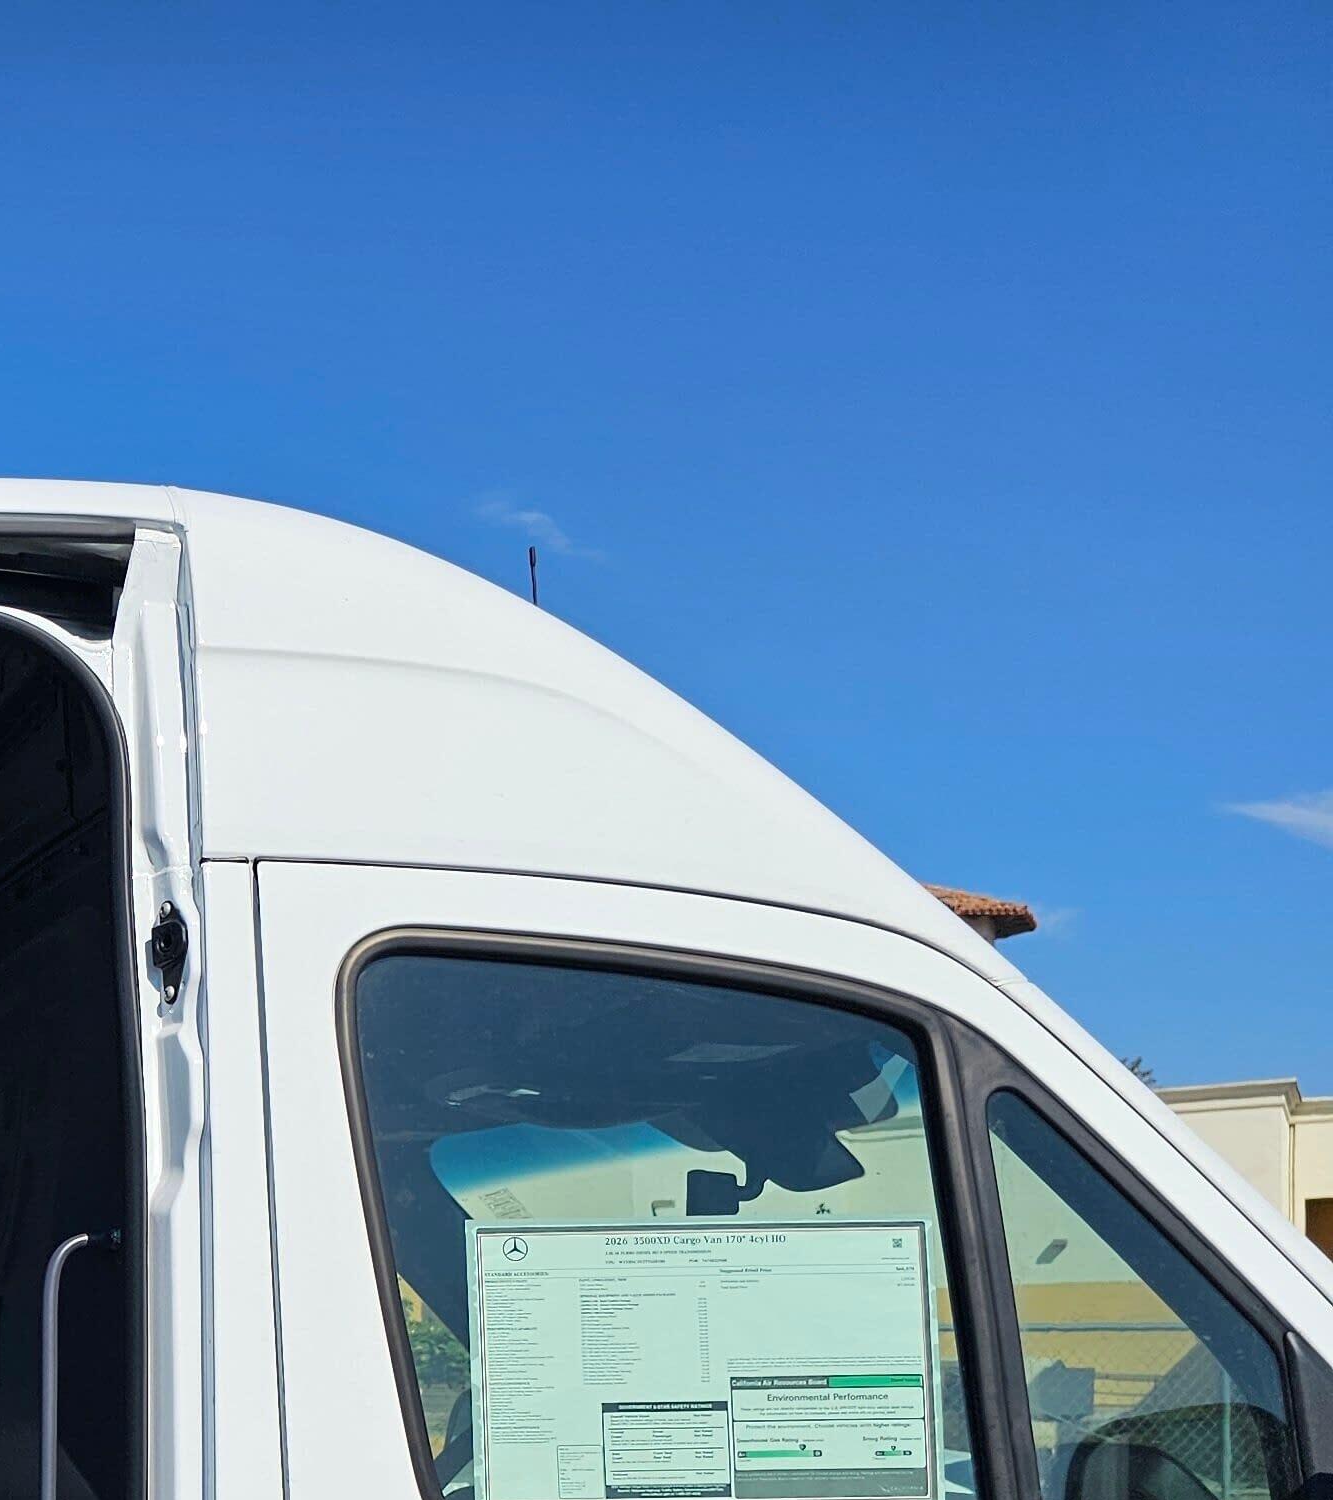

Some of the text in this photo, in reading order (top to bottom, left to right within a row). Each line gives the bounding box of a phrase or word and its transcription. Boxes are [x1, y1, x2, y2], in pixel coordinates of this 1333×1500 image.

[605, 1237, 628, 1246] 2026
[633, 1236, 671, 1245] 3500XD
[673, 1236, 701, 1245] Cargo
[703, 1235, 722, 1244] Van
[767, 1392, 889, 1402] Environmental Performance
